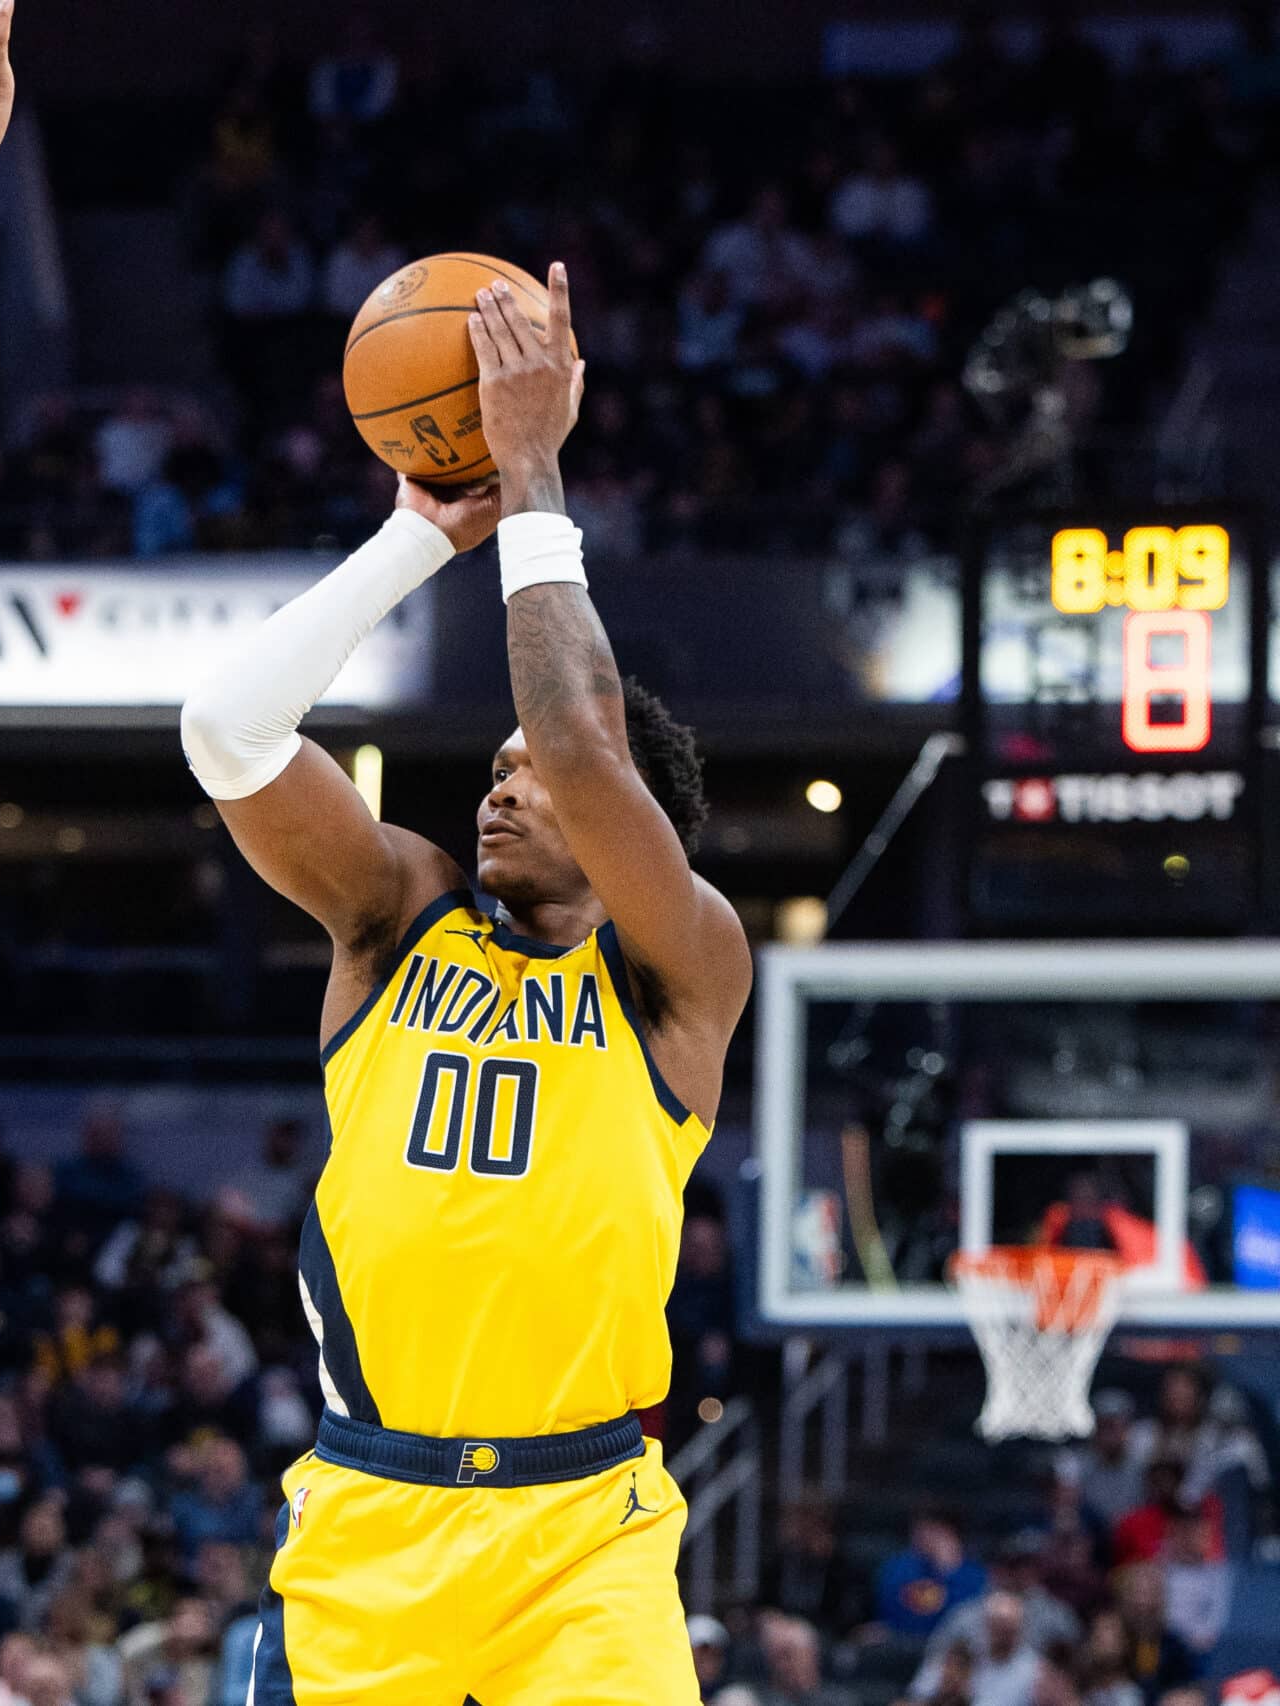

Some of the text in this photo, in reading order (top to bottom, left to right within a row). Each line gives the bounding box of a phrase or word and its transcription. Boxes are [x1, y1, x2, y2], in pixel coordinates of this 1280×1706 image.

[1051, 524, 1230, 614] 8:09
[1121, 609, 1213, 753] 8
[389, 952, 609, 1051] INDIANA
[405, 1051, 538, 1178] 00
